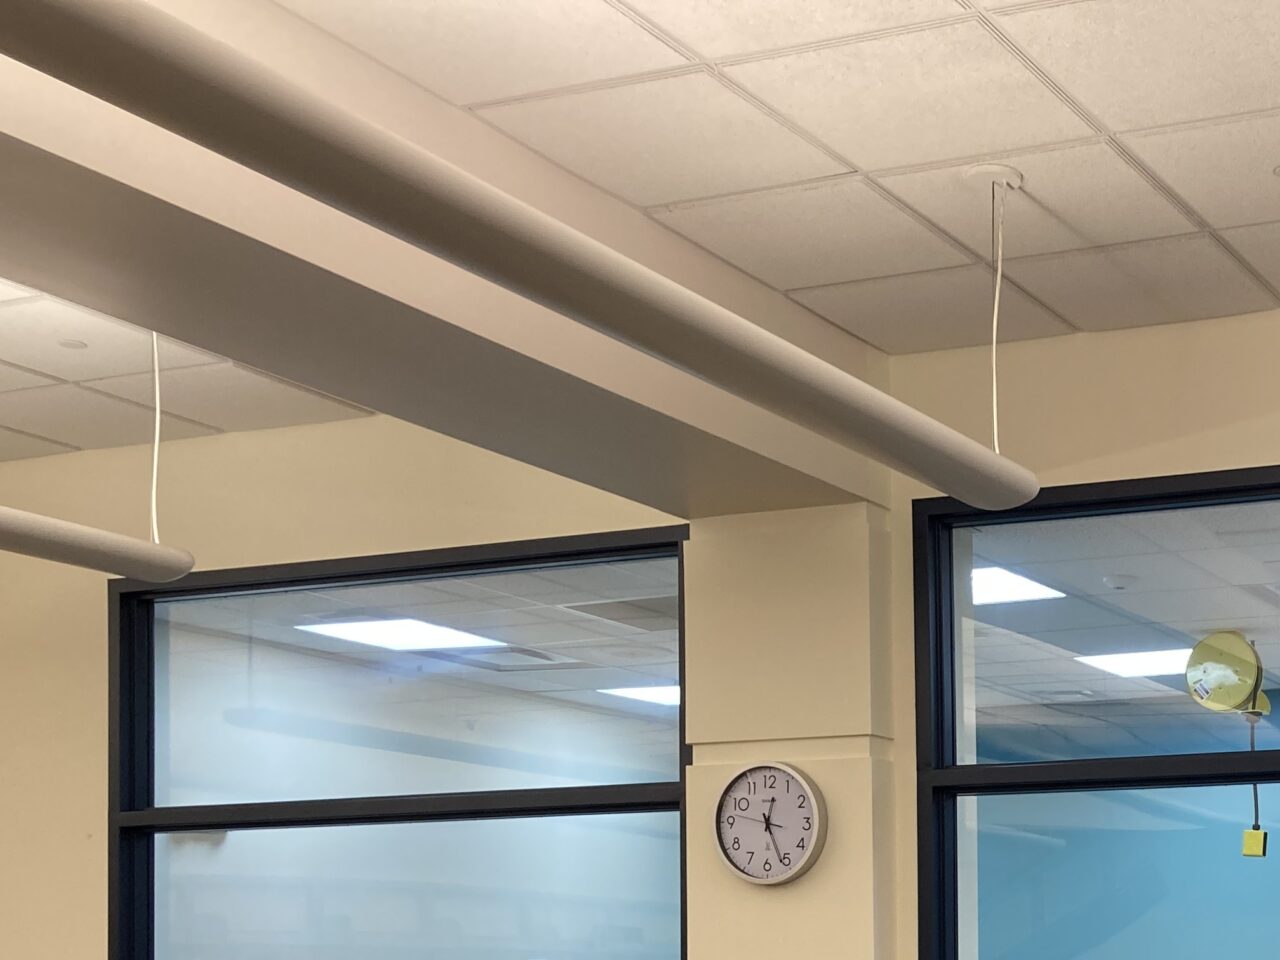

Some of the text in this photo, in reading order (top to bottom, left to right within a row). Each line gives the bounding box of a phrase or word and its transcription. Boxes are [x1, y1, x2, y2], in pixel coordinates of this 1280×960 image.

[747, 781, 756, 795] 11
[763, 775, 777, 789] 12
[785, 780, 790, 793] 1
[733, 797, 750, 811] 10
[797, 795, 806, 809] 2
[726, 815, 736, 829] 9
[802, 816, 812, 831] 3
[732, 837, 741, 851] 8
[796, 837, 806, 850] 4
[746, 851, 755, 865] 7
[763, 858, 772, 872] 6
[782, 853, 791, 866] 5
